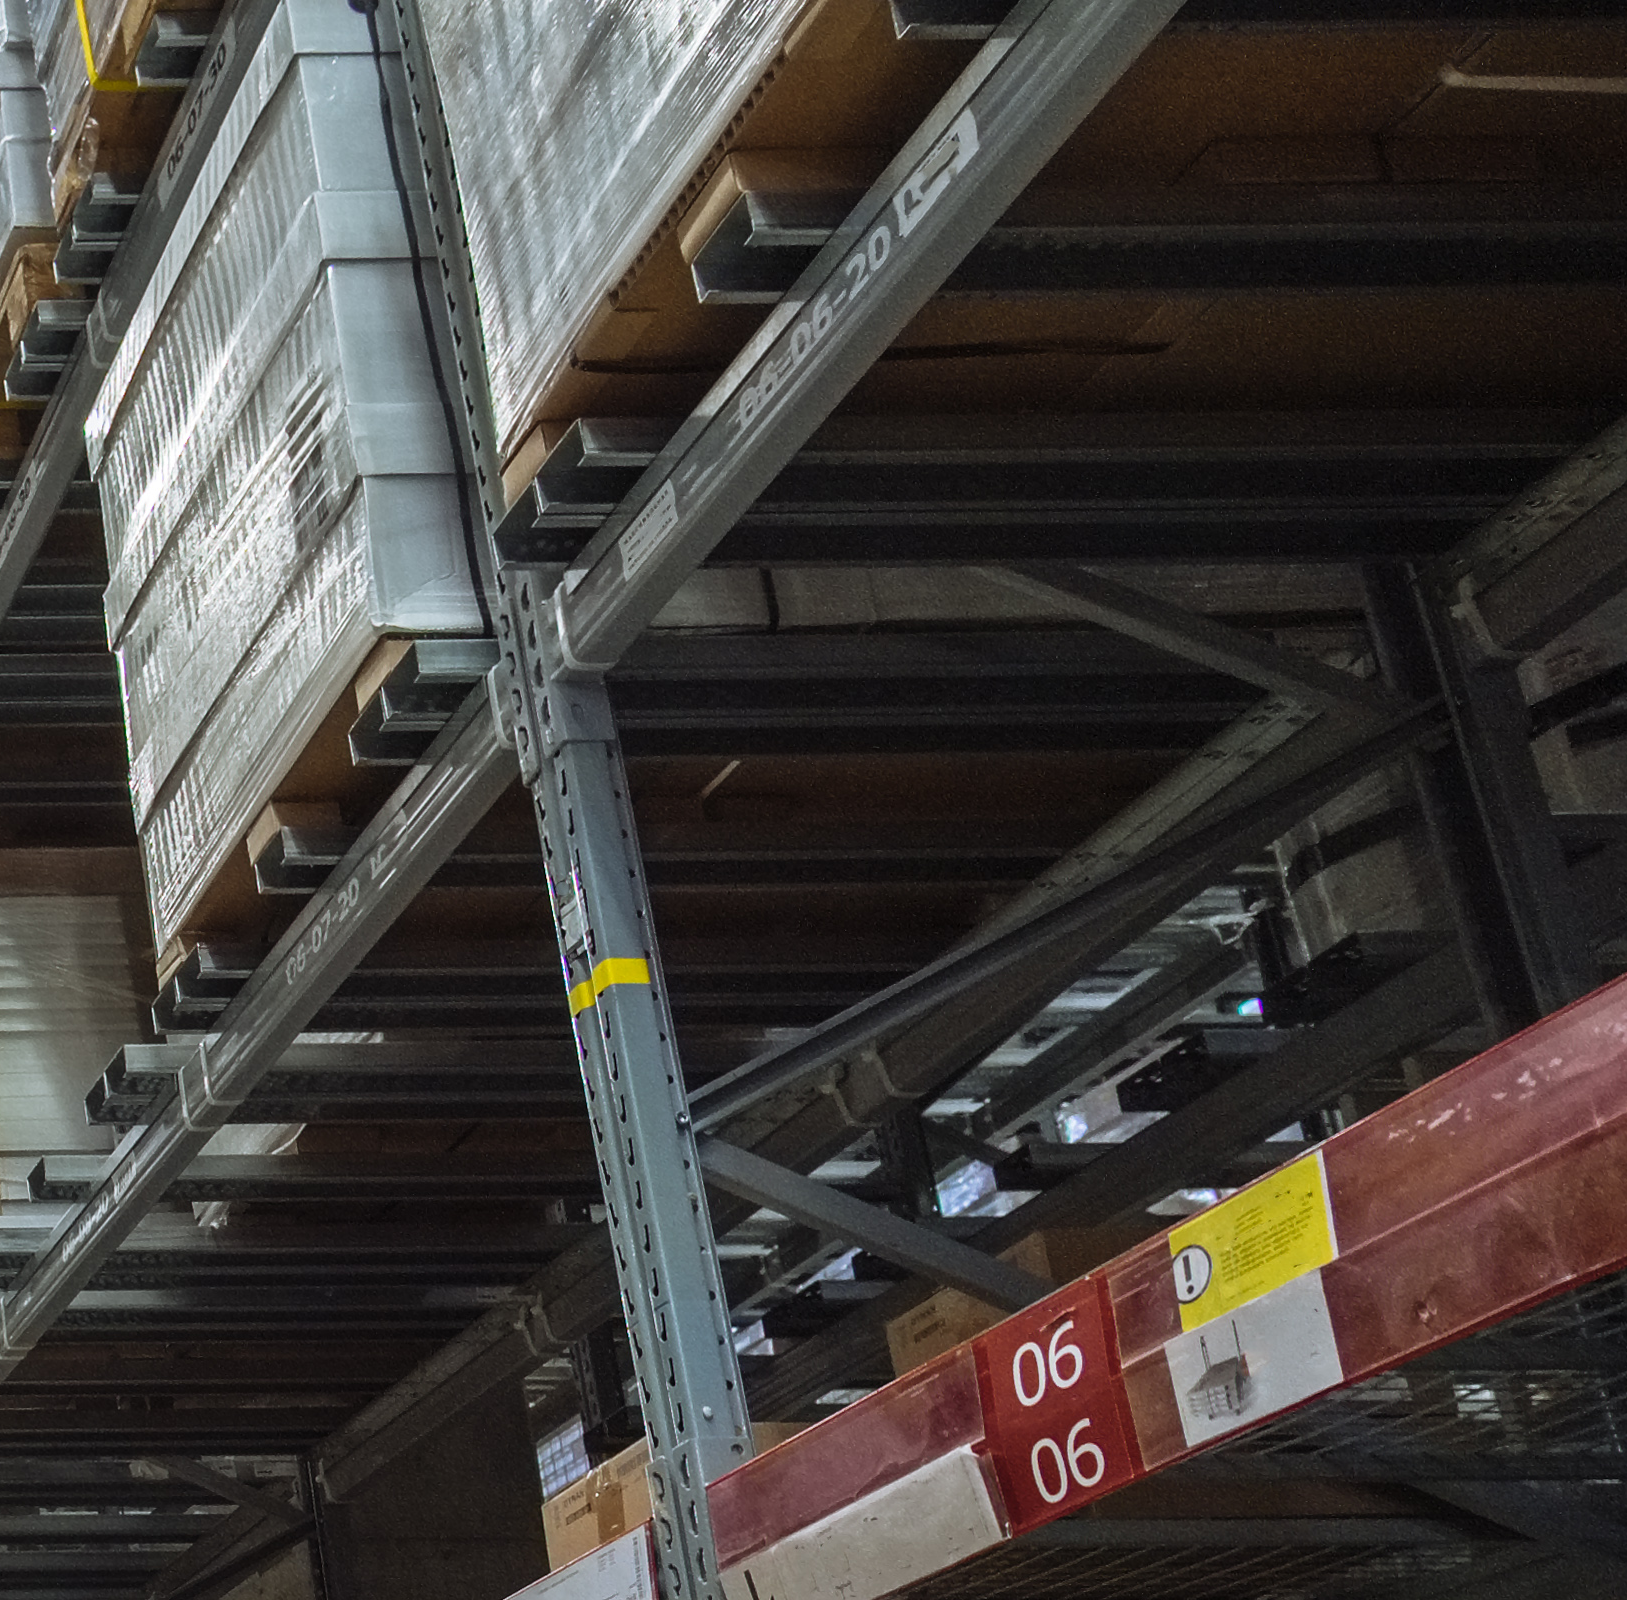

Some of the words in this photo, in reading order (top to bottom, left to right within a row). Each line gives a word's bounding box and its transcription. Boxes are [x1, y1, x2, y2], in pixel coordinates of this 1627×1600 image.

[166, 42, 228, 179] 06-07-30
[739, 225, 892, 430] 06-06-20
[284, 877, 360, 986] 06-07-20
[1012, 1319, 1083, 1406] 06
[1030, 1417, 1105, 1503] 06
